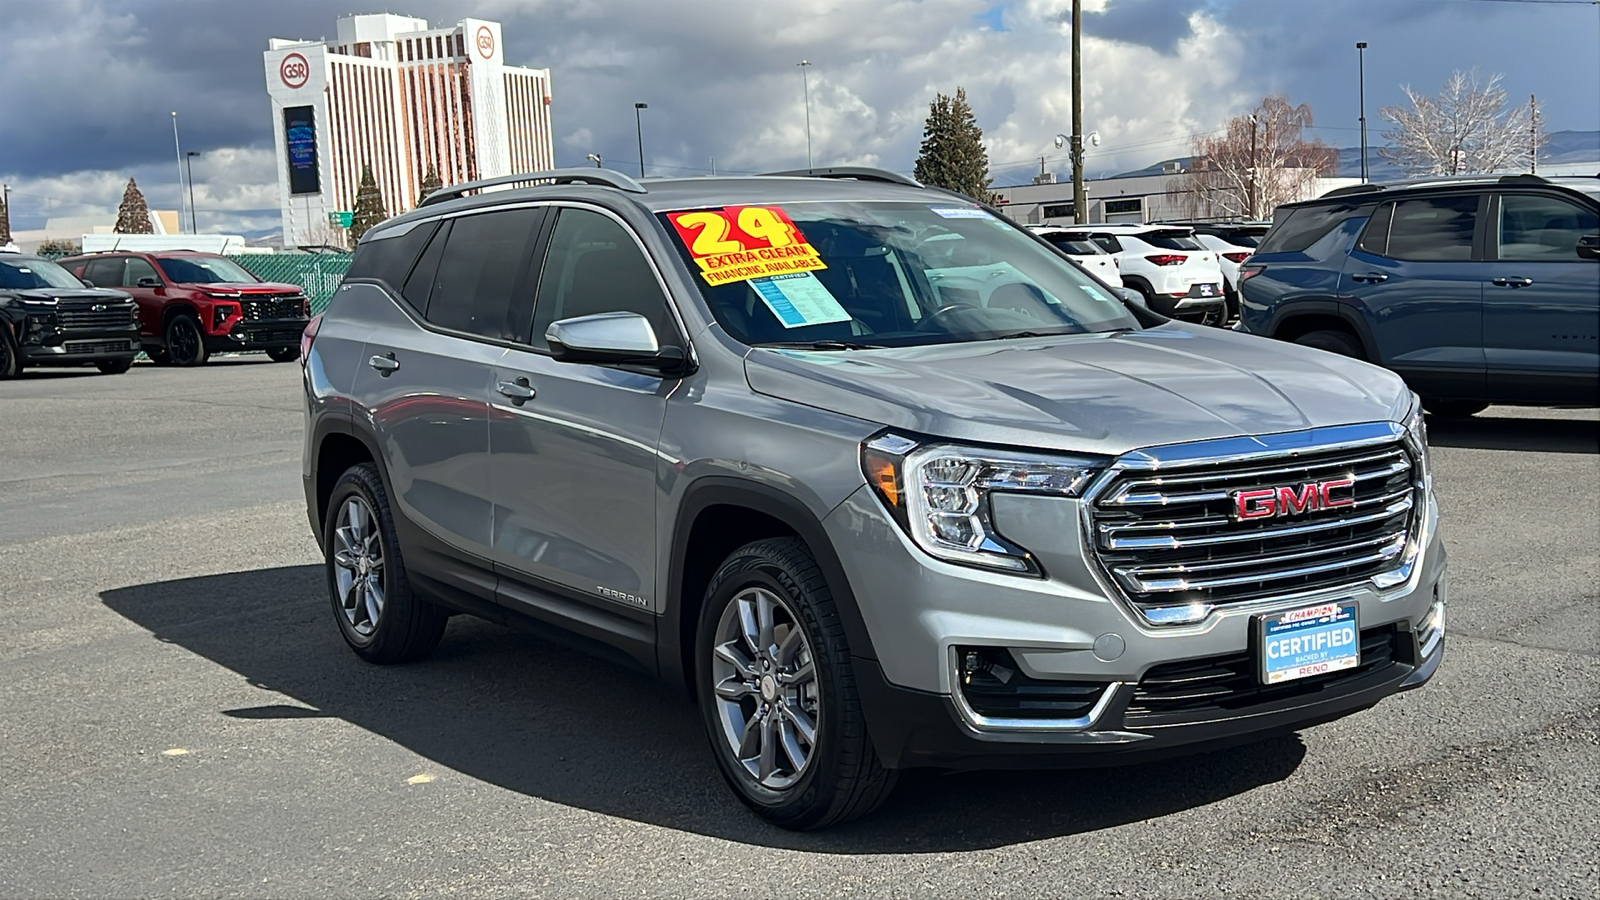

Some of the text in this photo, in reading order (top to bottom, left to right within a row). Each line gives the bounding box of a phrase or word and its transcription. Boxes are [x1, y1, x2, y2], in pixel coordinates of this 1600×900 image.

[284, 62, 305, 78] GSR
[676, 207, 795, 255] 24
[705, 245, 810, 269] EXTRA CLEAN
[706, 257, 821, 283] FINANCING AVAILABLE
[1235, 479, 1355, 523] GMC
[596, 585, 647, 606] TERRAIN
[1289, 606, 1333, 621] CHAMPION
[1268, 627, 1354, 659] CERTIFIED
[1296, 653, 1319, 663] BACKED
[1299, 663, 1328, 676] RENO
